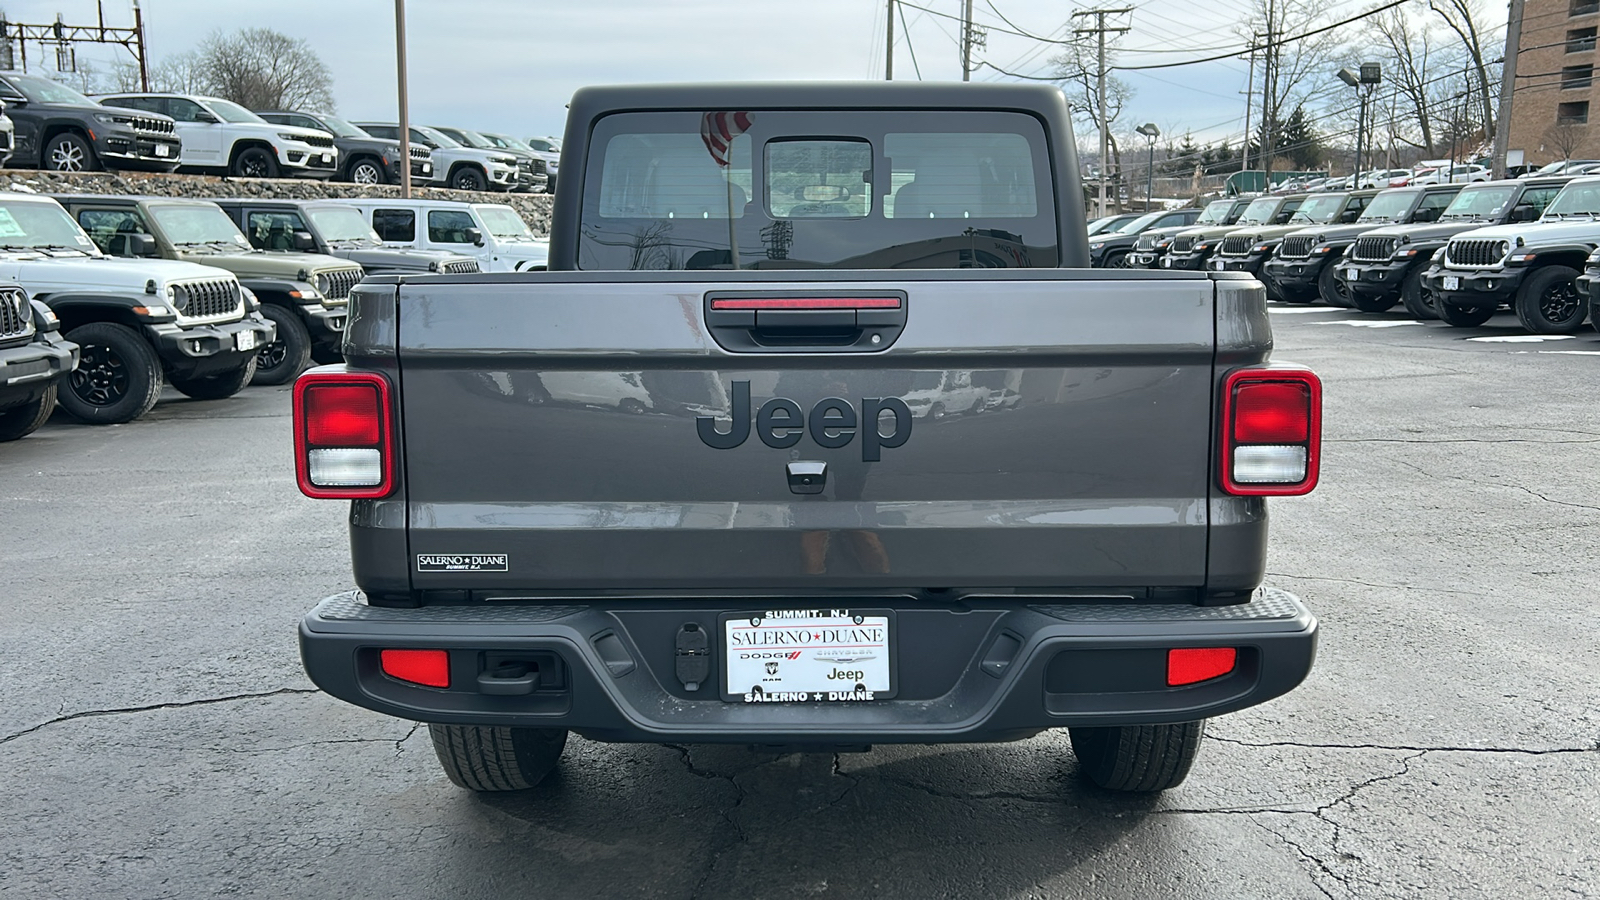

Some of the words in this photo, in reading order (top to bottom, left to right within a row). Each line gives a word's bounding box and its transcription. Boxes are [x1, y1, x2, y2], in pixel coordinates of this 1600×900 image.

[696, 380, 913, 463] Jeep
[420, 556, 463, 565] SALERNO
[472, 556, 505, 565] DUANE
[831, 609, 849, 618] NJ
[732, 630, 812, 646] SALERNO
[822, 628, 883, 644] DUANE
[740, 652, 794, 660] DODGE
[827, 667, 864, 682] Jeep
[744, 692, 808, 703] SALERNO
[828, 691, 875, 702] DUANE
